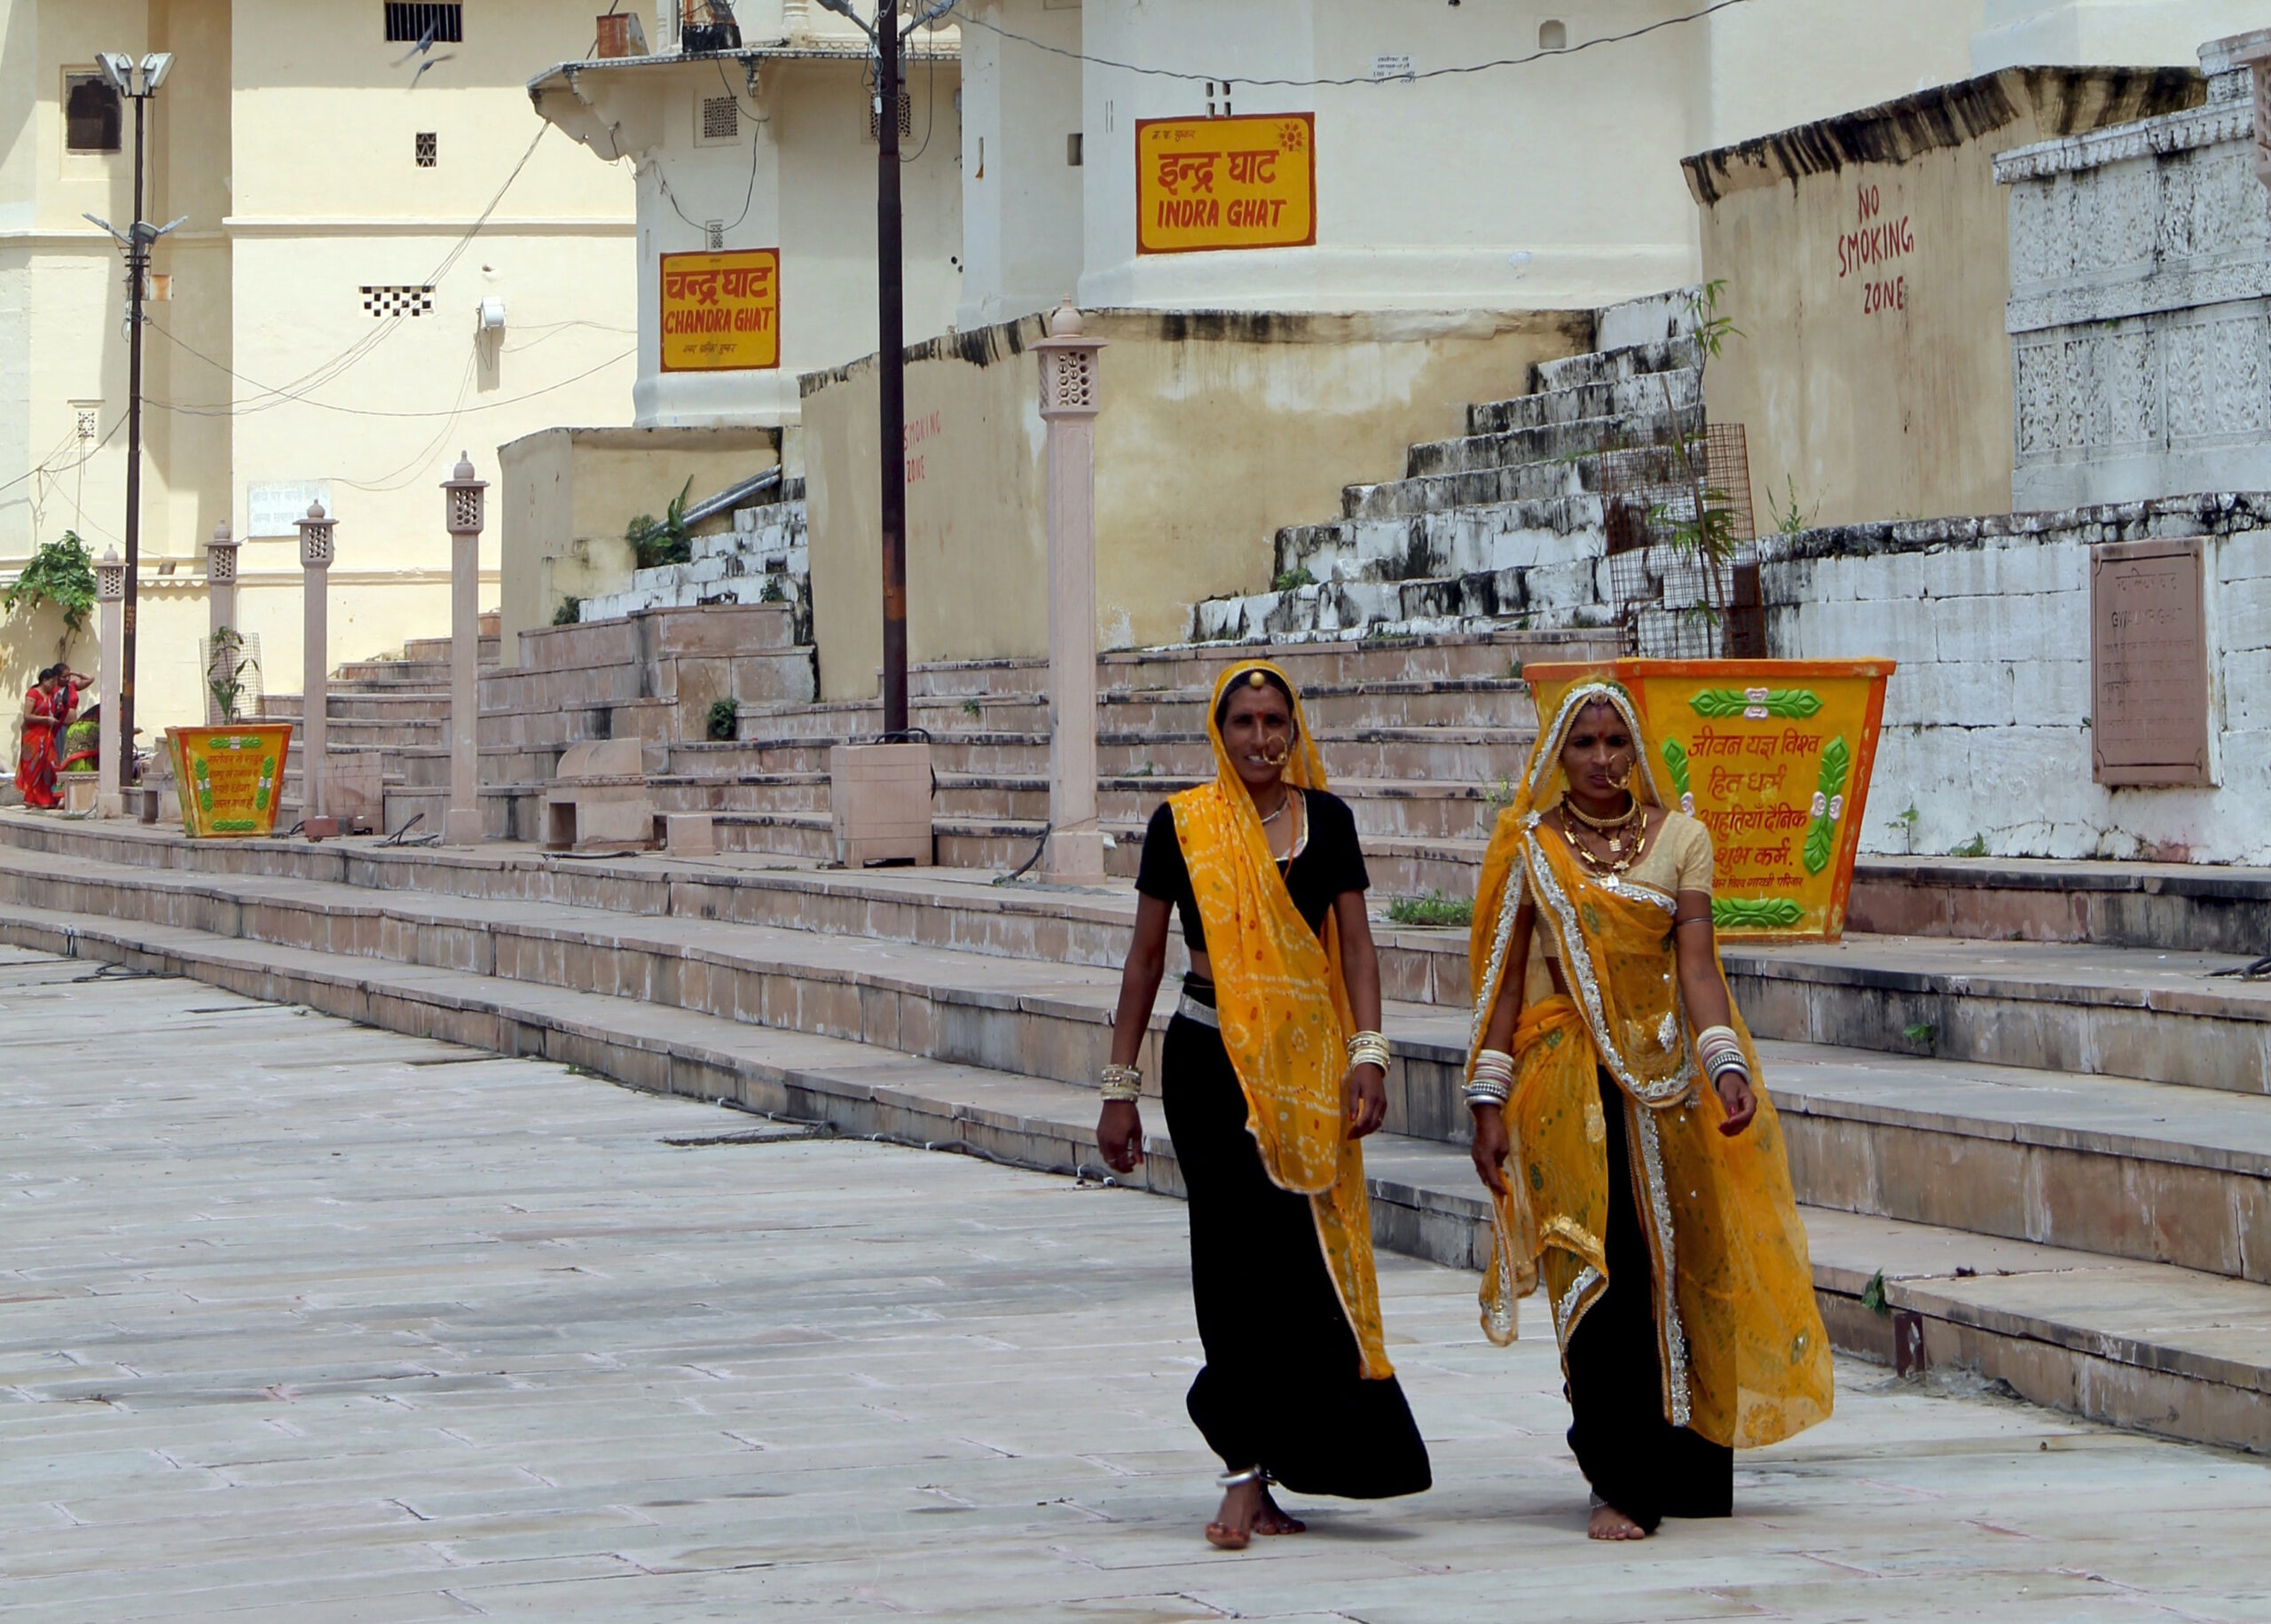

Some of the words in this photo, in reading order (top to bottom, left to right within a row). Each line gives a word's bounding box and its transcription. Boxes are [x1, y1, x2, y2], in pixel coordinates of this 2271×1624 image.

[1157, 151, 1222, 196] इन्द्र
[1227, 149, 1280, 184] घाट
[1157, 198, 1220, 229] INDRA
[1227, 198, 1287, 228] GHAT
[1858, 184, 1880, 224] NO
[1838, 216, 1914, 278] SMOKING
[665, 269, 721, 306] चन्द्र
[721, 266, 774, 298] घाट
[1864, 275, 1904, 315] ZONE
[664, 308, 732, 335] CHANDRA
[735, 306, 774, 333] GHAT
[907, 454, 925, 483] ZONE
[1687, 725, 1745, 757] जीवन
[1746, 735, 1778, 761] यज्ञ
[1780, 727, 1823, 757] विश्व
[1707, 765, 1745, 801] हित
[1745, 763, 1788, 792] धर्म
[1764, 802, 1807, 833] दैनिक
[1713, 845, 1753, 875] शुभ
[1754, 837, 1794, 867] कर्म.
